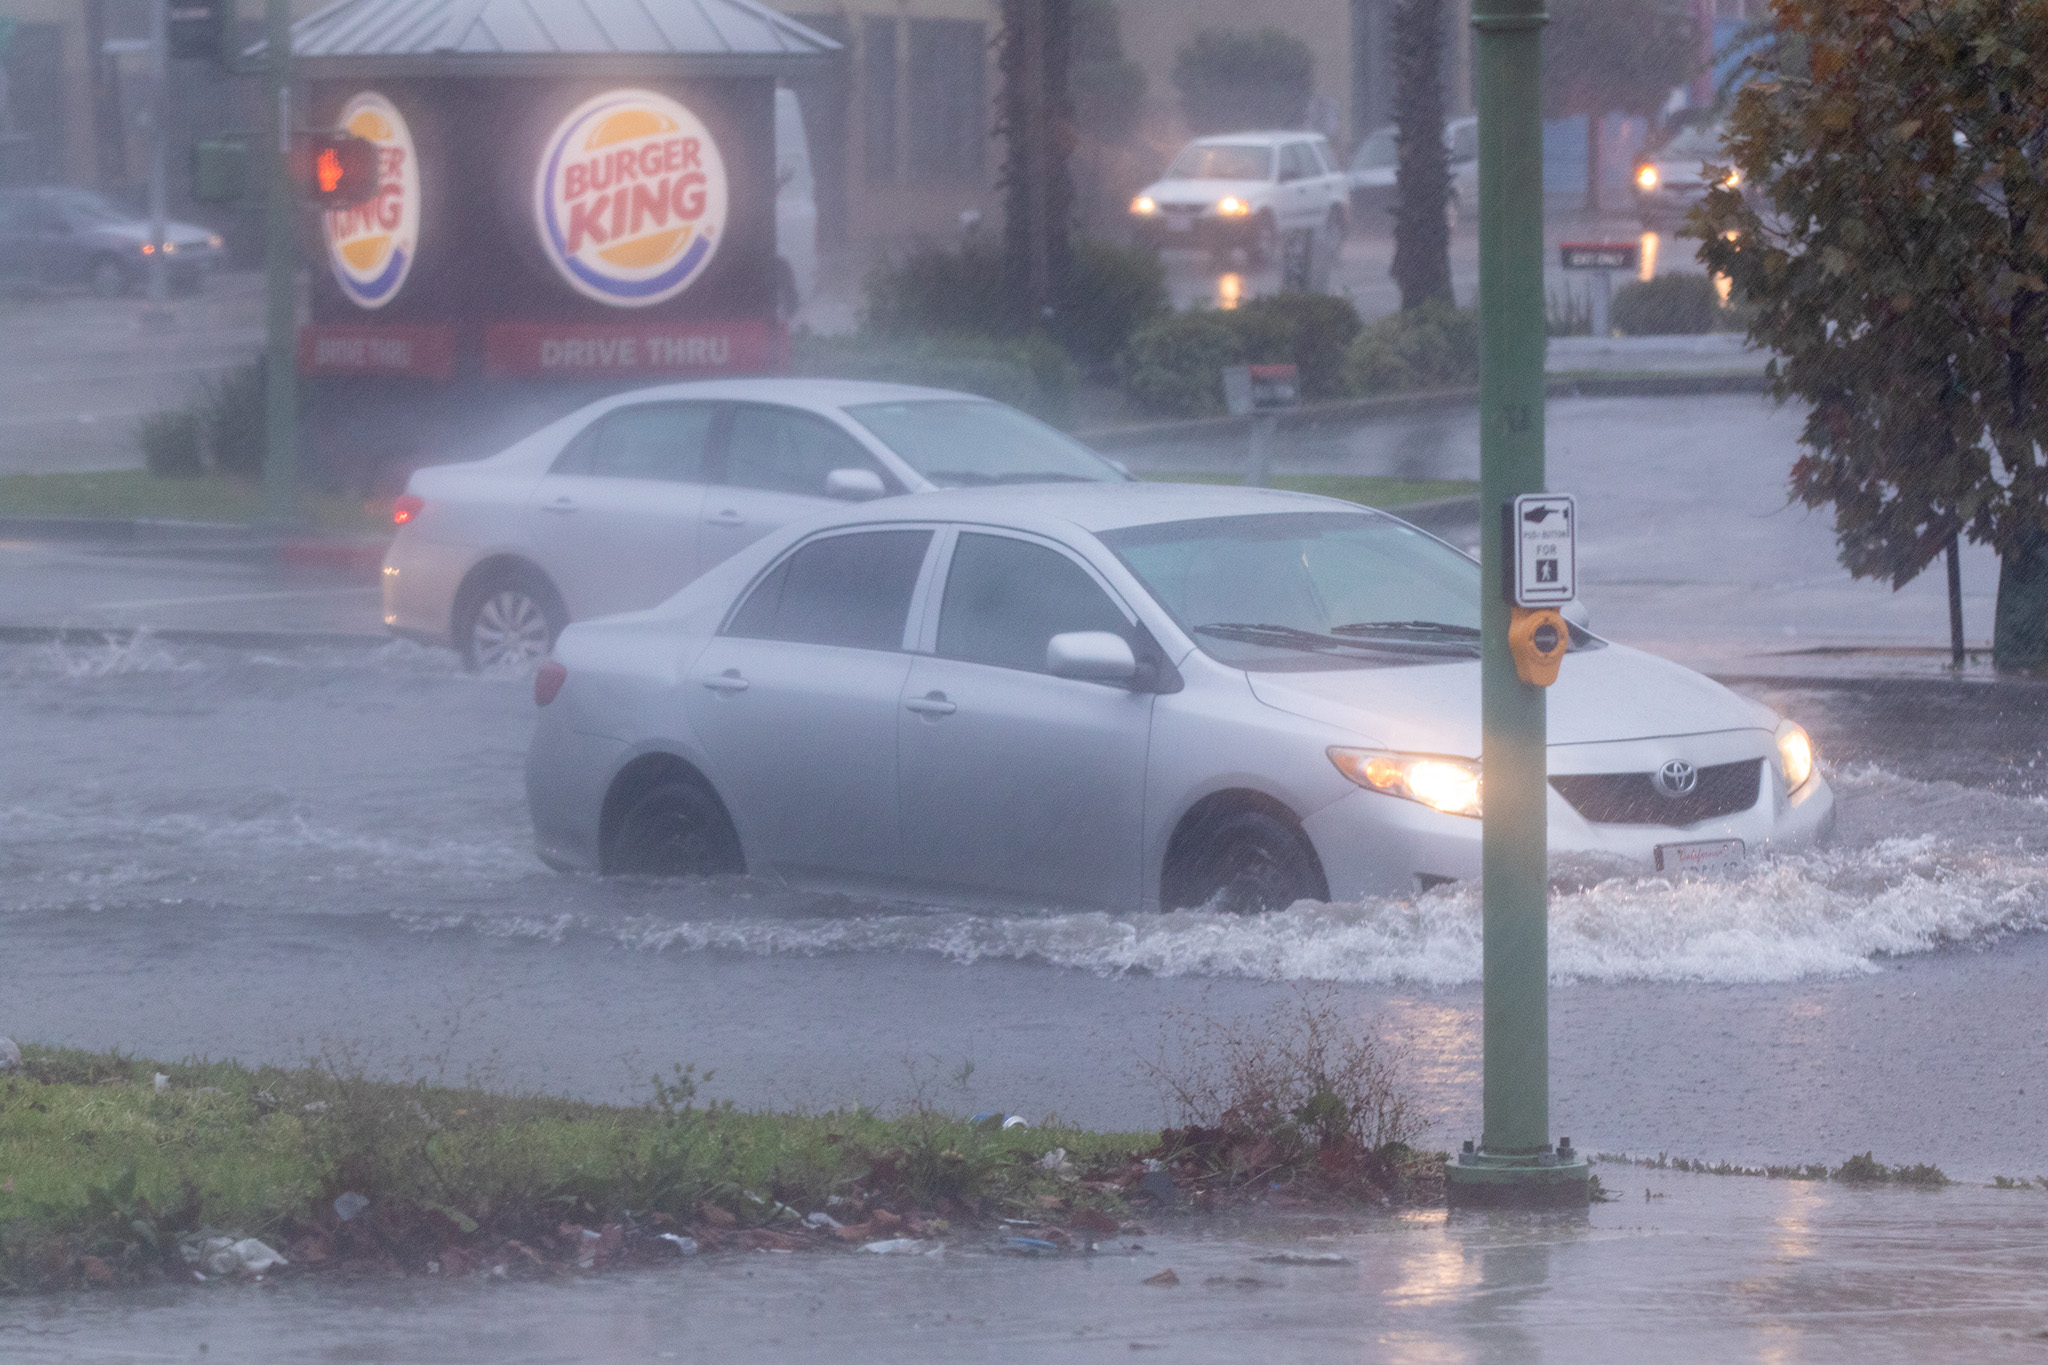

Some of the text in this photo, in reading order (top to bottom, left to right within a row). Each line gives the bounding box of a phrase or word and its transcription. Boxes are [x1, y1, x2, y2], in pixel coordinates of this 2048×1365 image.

[565, 137, 701, 203] BURGER
[567, 171, 706, 255] KING
[541, 337, 729, 367] DRIVE THRU
[1536, 544, 1557, 555] FOR
